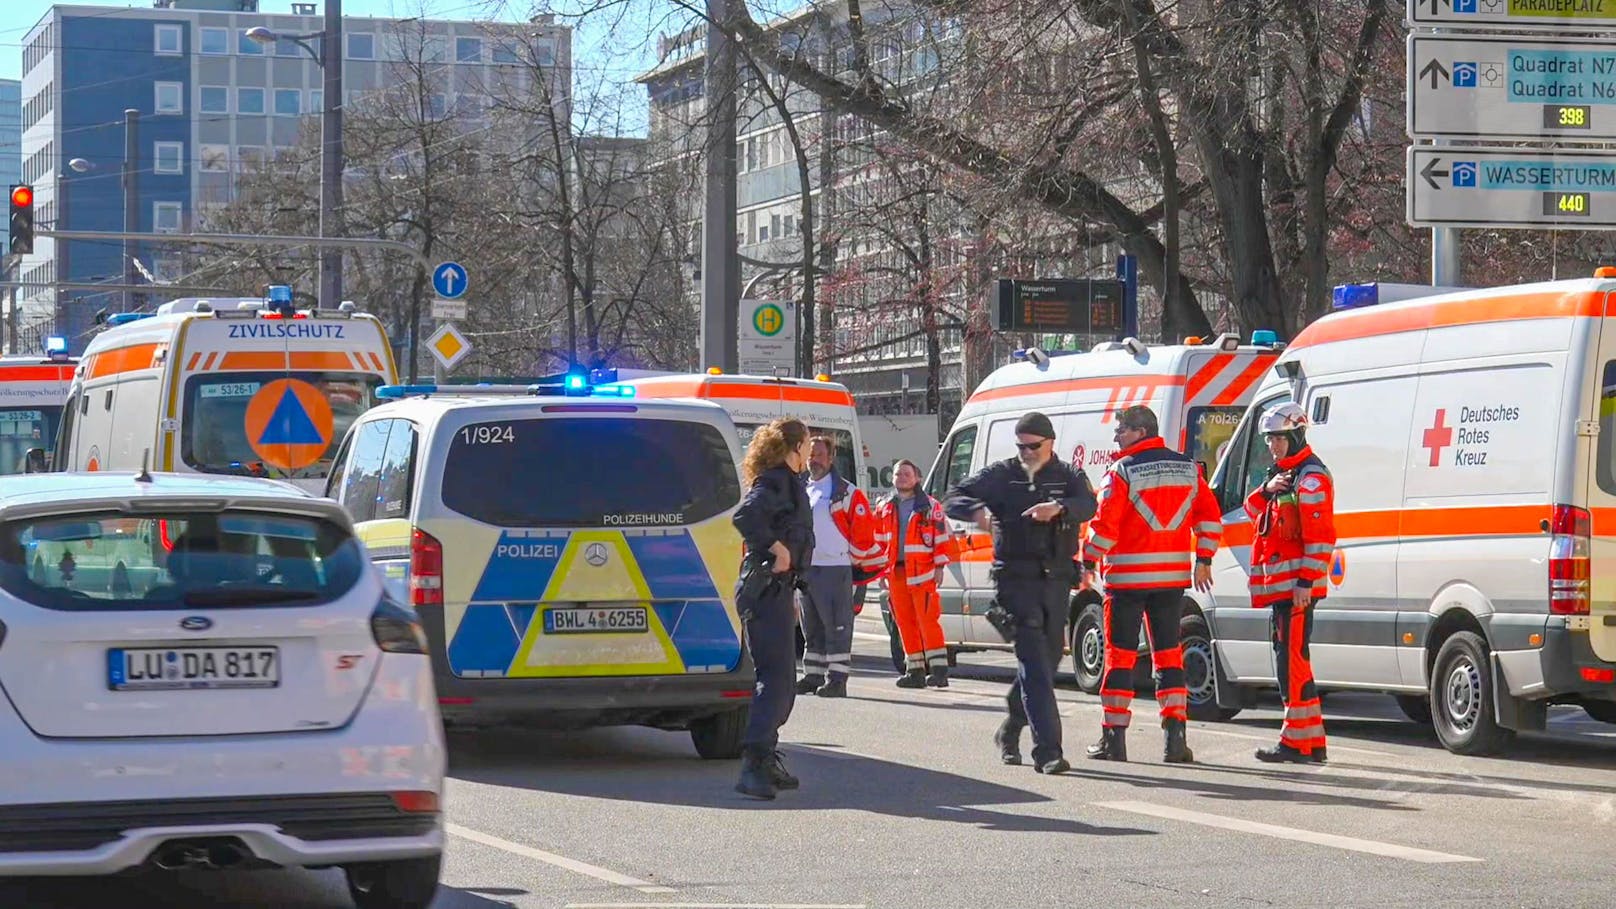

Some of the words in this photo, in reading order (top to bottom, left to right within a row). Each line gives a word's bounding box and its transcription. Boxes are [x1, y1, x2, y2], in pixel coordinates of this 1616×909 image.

[1512, 0, 1603, 13] PARADEPLATZ
[1513, 55, 1584, 74] Quadrat
[1592, 57, 1616, 74] N7
[1513, 79, 1584, 98] Quadrat
[1592, 81, 1616, 98] N6
[1559, 108, 1584, 125] 398
[1486, 166, 1616, 186] WASSERTURM
[1558, 194, 1584, 212] 440
[228, 324, 345, 338] ZIVILSCHUTZ
[220, 384, 253, 395] 53/26-1
[1460, 404, 1520, 424] Deutsches
[461, 426, 515, 444] 1/924
[1457, 427, 1490, 445] Rotes
[1455, 448, 1488, 466] Kreuz
[603, 513, 684, 525] POLIZEIHUNDE
[497, 544, 558, 558] POLIZEI
[555, 611, 585, 628] BWL
[588, 611, 597, 628] 4
[608, 610, 645, 627] 6255
[127, 653, 163, 680] LU
[183, 652, 219, 679] DA
[225, 652, 274, 679] 817
